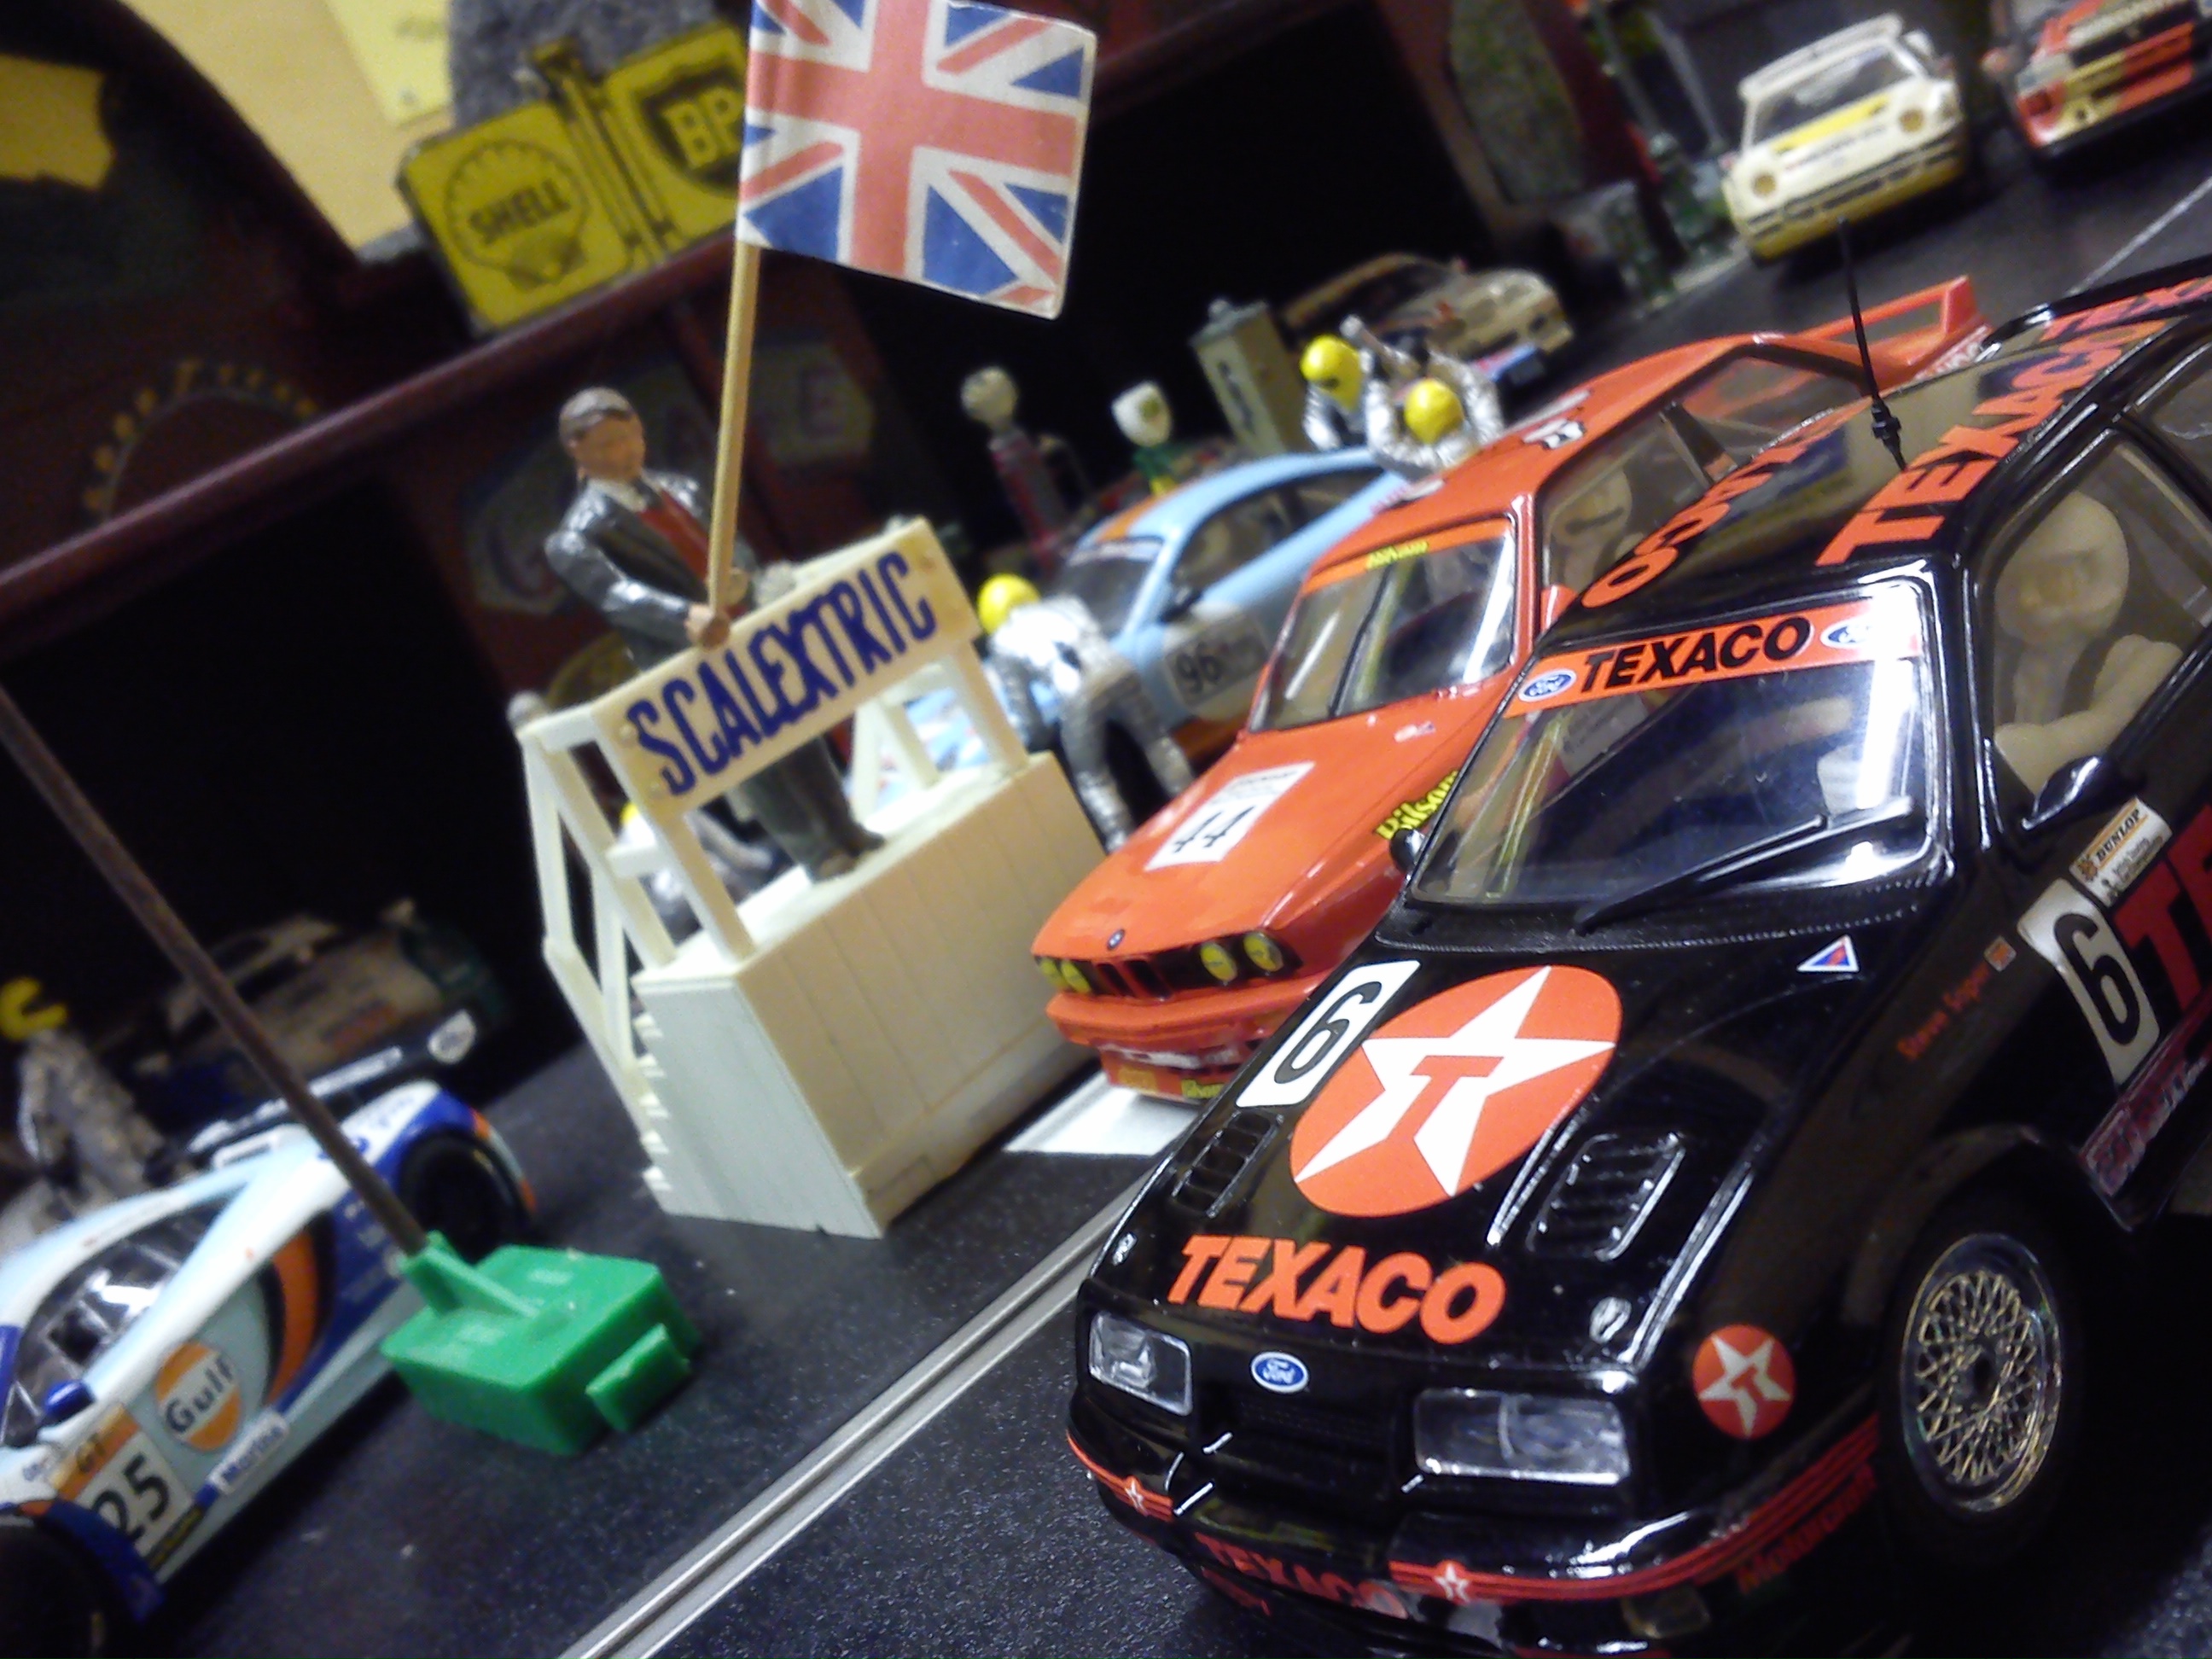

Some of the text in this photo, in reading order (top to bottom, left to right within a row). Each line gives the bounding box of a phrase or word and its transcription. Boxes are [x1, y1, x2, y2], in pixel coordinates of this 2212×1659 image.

[662, 86, 745, 170] BP
[469, 178, 571, 246] SHELL
[1815, 318, 2168, 567] TEXACO
[626, 550, 937, 797] SCALEXTRIC
[1175, 641, 1224, 695] 96
[1581, 617, 1812, 692] TEXACO
[1173, 805, 1257, 854] 44
[2095, 809, 2141, 864] DUNLOP
[2053, 912, 2141, 1046] 6
[1273, 981, 1383, 1085] 6
[1167, 1234, 1507, 1346] TEXACO
[165, 1353, 235, 1434] Gulf
[90, 1452, 170, 1541] 25
[1195, 1531, 1407, 1620] TEXACO
